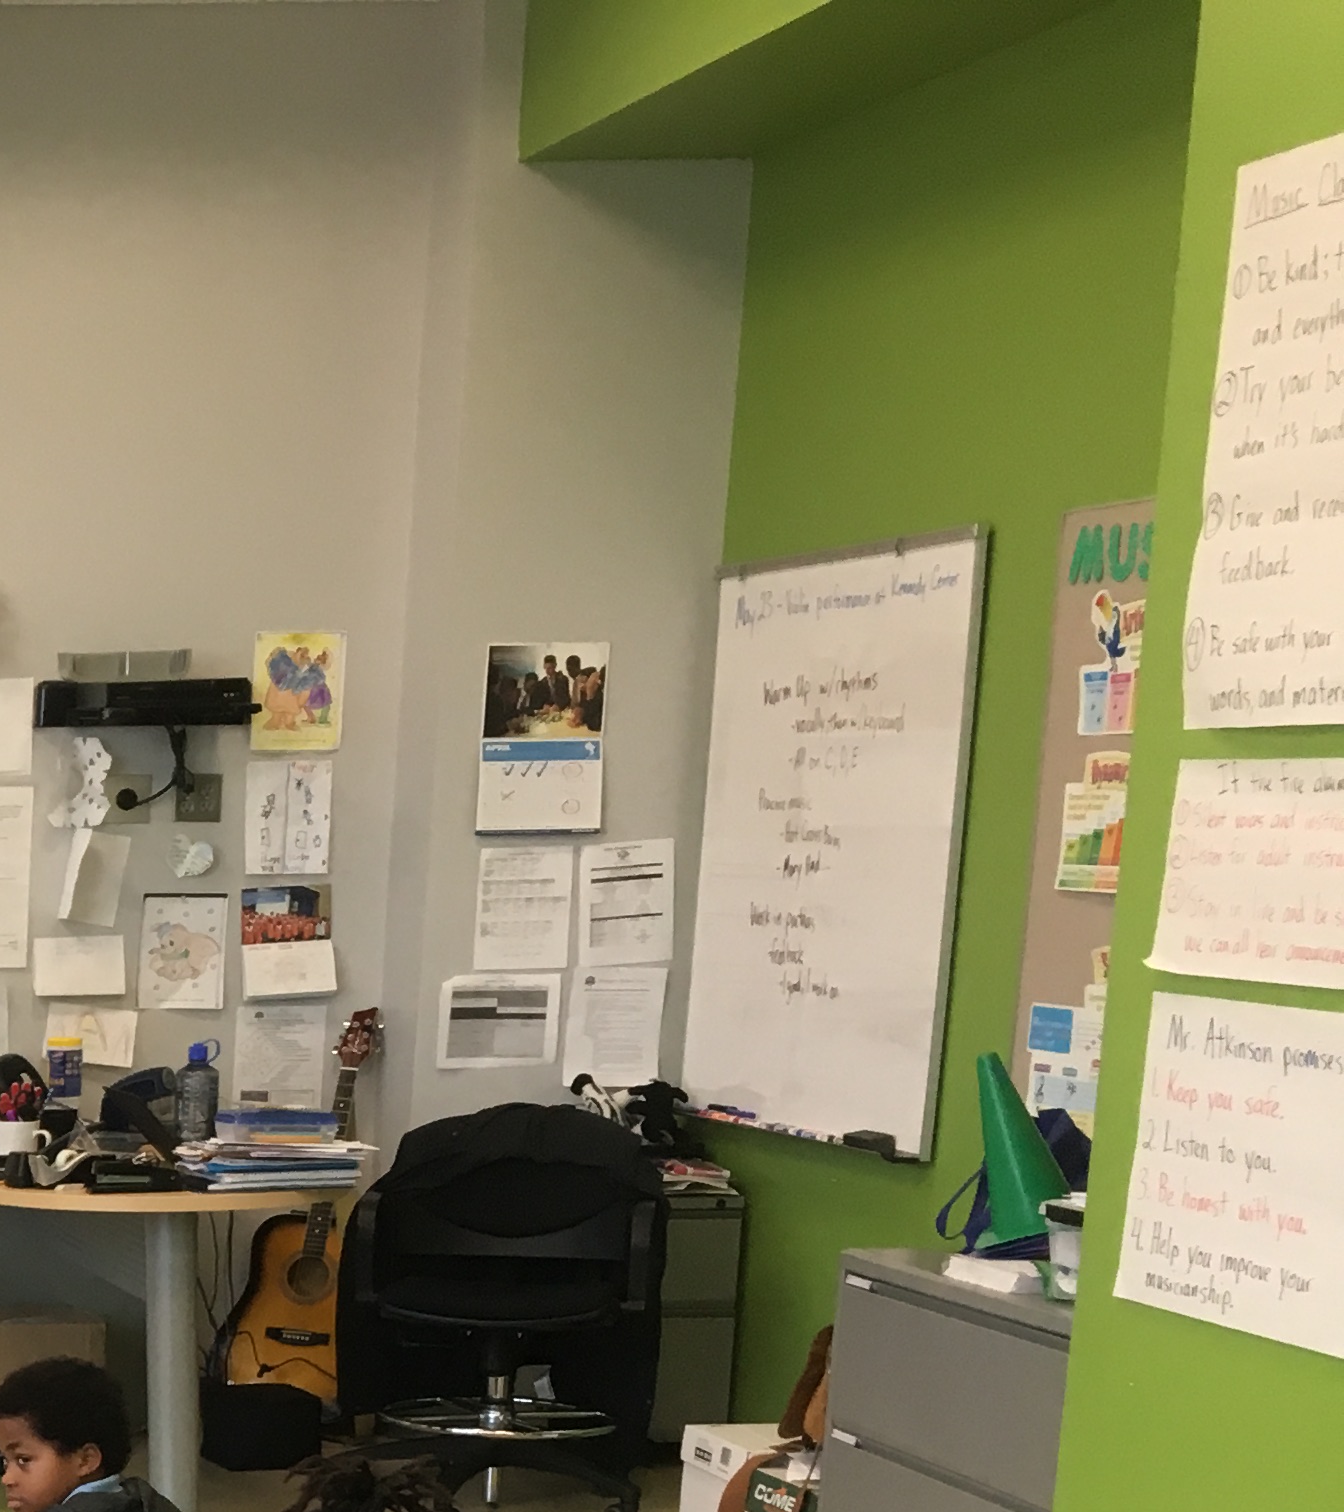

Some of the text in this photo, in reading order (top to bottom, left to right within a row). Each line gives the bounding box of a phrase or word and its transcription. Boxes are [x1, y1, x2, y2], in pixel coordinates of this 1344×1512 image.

[1257, 255, 1278, 293] Be
[1252, 307, 1283, 346] and
[1239, 365, 1314, 417] Try your
[1233, 425, 1265, 459] when
[1229, 489, 1299, 531] Give and
[1210, 617, 1335, 664] Be safe with your
[1258, 674, 1287, 708] and
[1166, 1014, 1195, 1053] Mr.
[1203, 1016, 1273, 1063] Atkinson
[1166, 1068, 1198, 1110] Keep
[1207, 1091, 1233, 1121] you
[1244, 1084, 1284, 1120] safe.
[1163, 1119, 1277, 1183] Listen to you.
[1158, 1171, 1175, 1207] Be
[1181, 1175, 1229, 1218] honest
[1238, 1194, 1270, 1223] with
[1276, 1212, 1308, 1242] you.
[1150, 1221, 1179, 1266] Help
[1186, 1245, 1212, 1274] you
[1220, 1253, 1272, 1284] improve
[1278, 1266, 1314, 1300] your
[1144, 1271, 1234, 1315] musicianship.
[754, 1483, 798, 1512] COME
